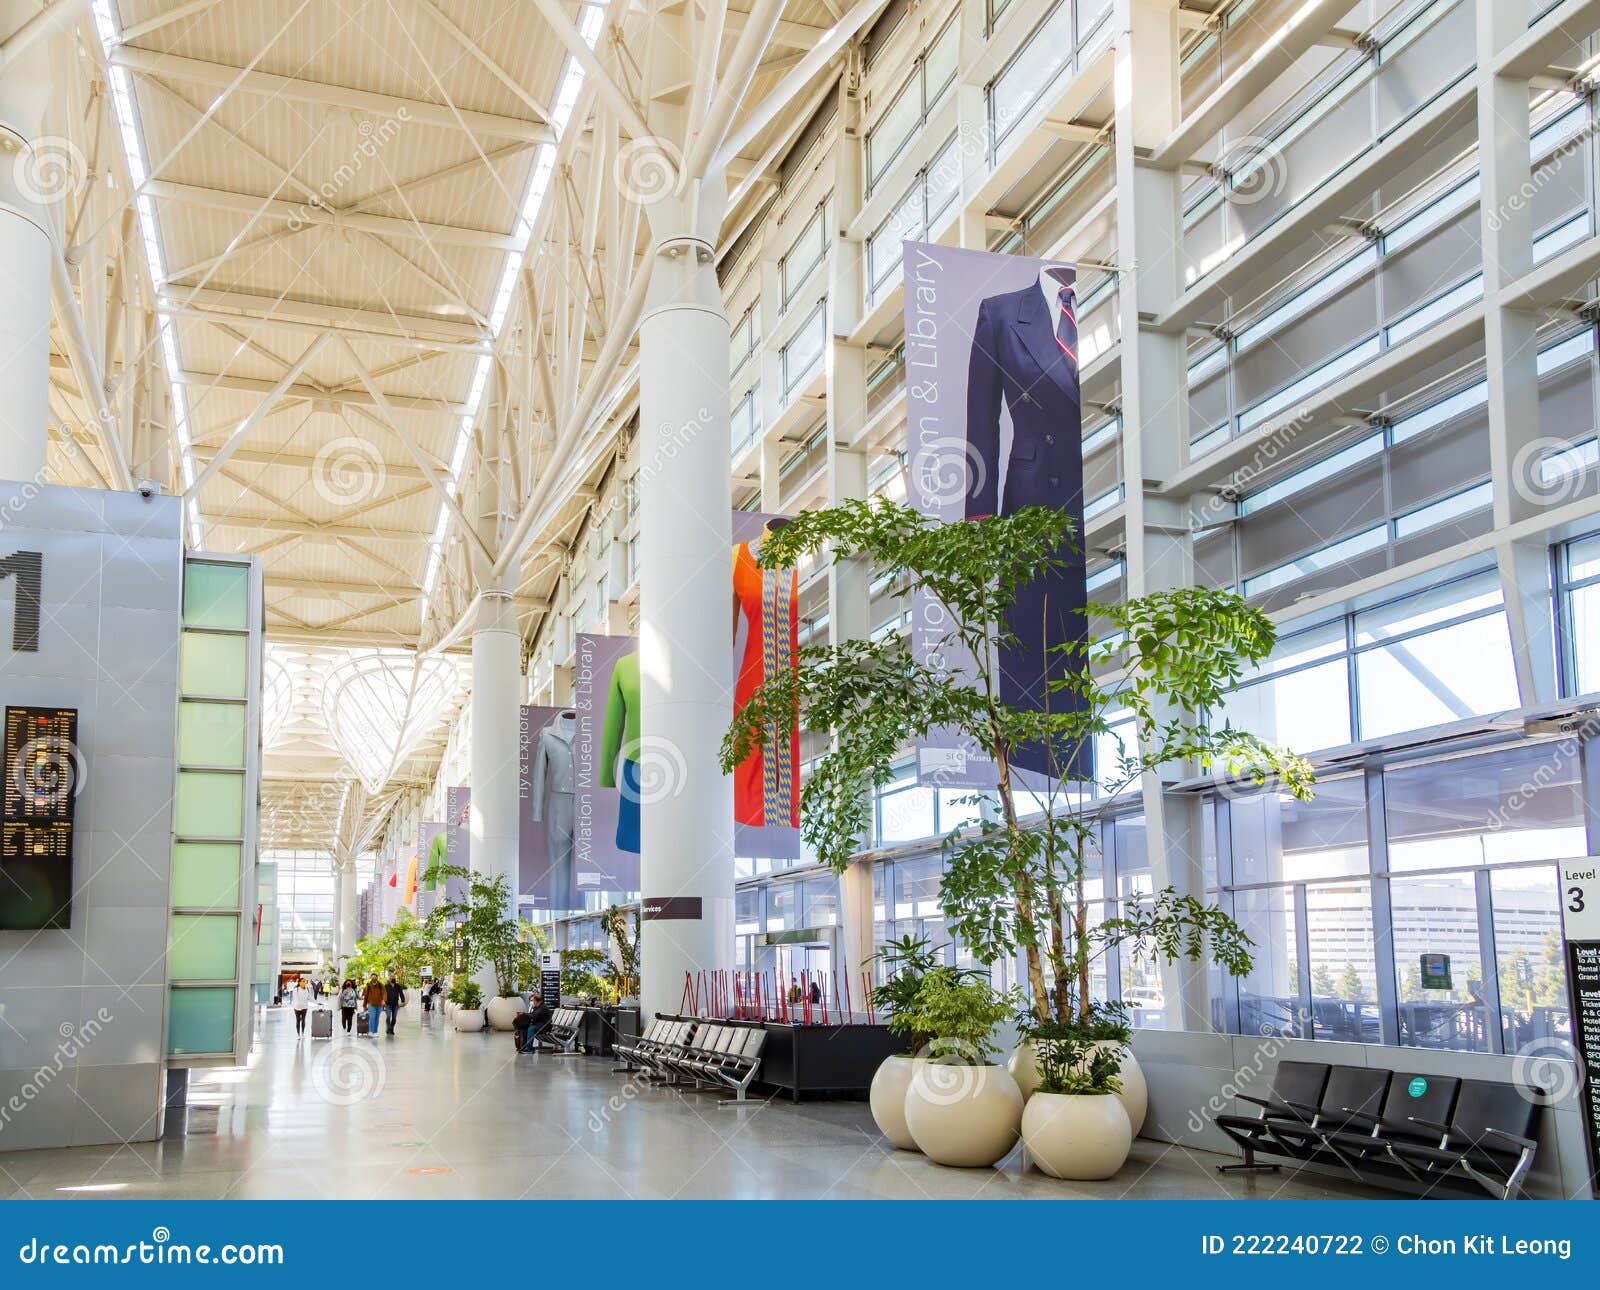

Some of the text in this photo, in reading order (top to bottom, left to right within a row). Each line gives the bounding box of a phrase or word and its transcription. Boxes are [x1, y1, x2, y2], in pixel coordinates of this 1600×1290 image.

[909, 249, 943, 368] Library
[911, 380, 938, 404] &
[919, 416, 942, 531] useum
[519, 706, 531, 763] Explore
[577, 637, 597, 863] Aviation Museum & Library
[519, 776, 531, 799] Fly
[1565, 868, 1596, 880] Level
[1567, 886, 1586, 913] 3
